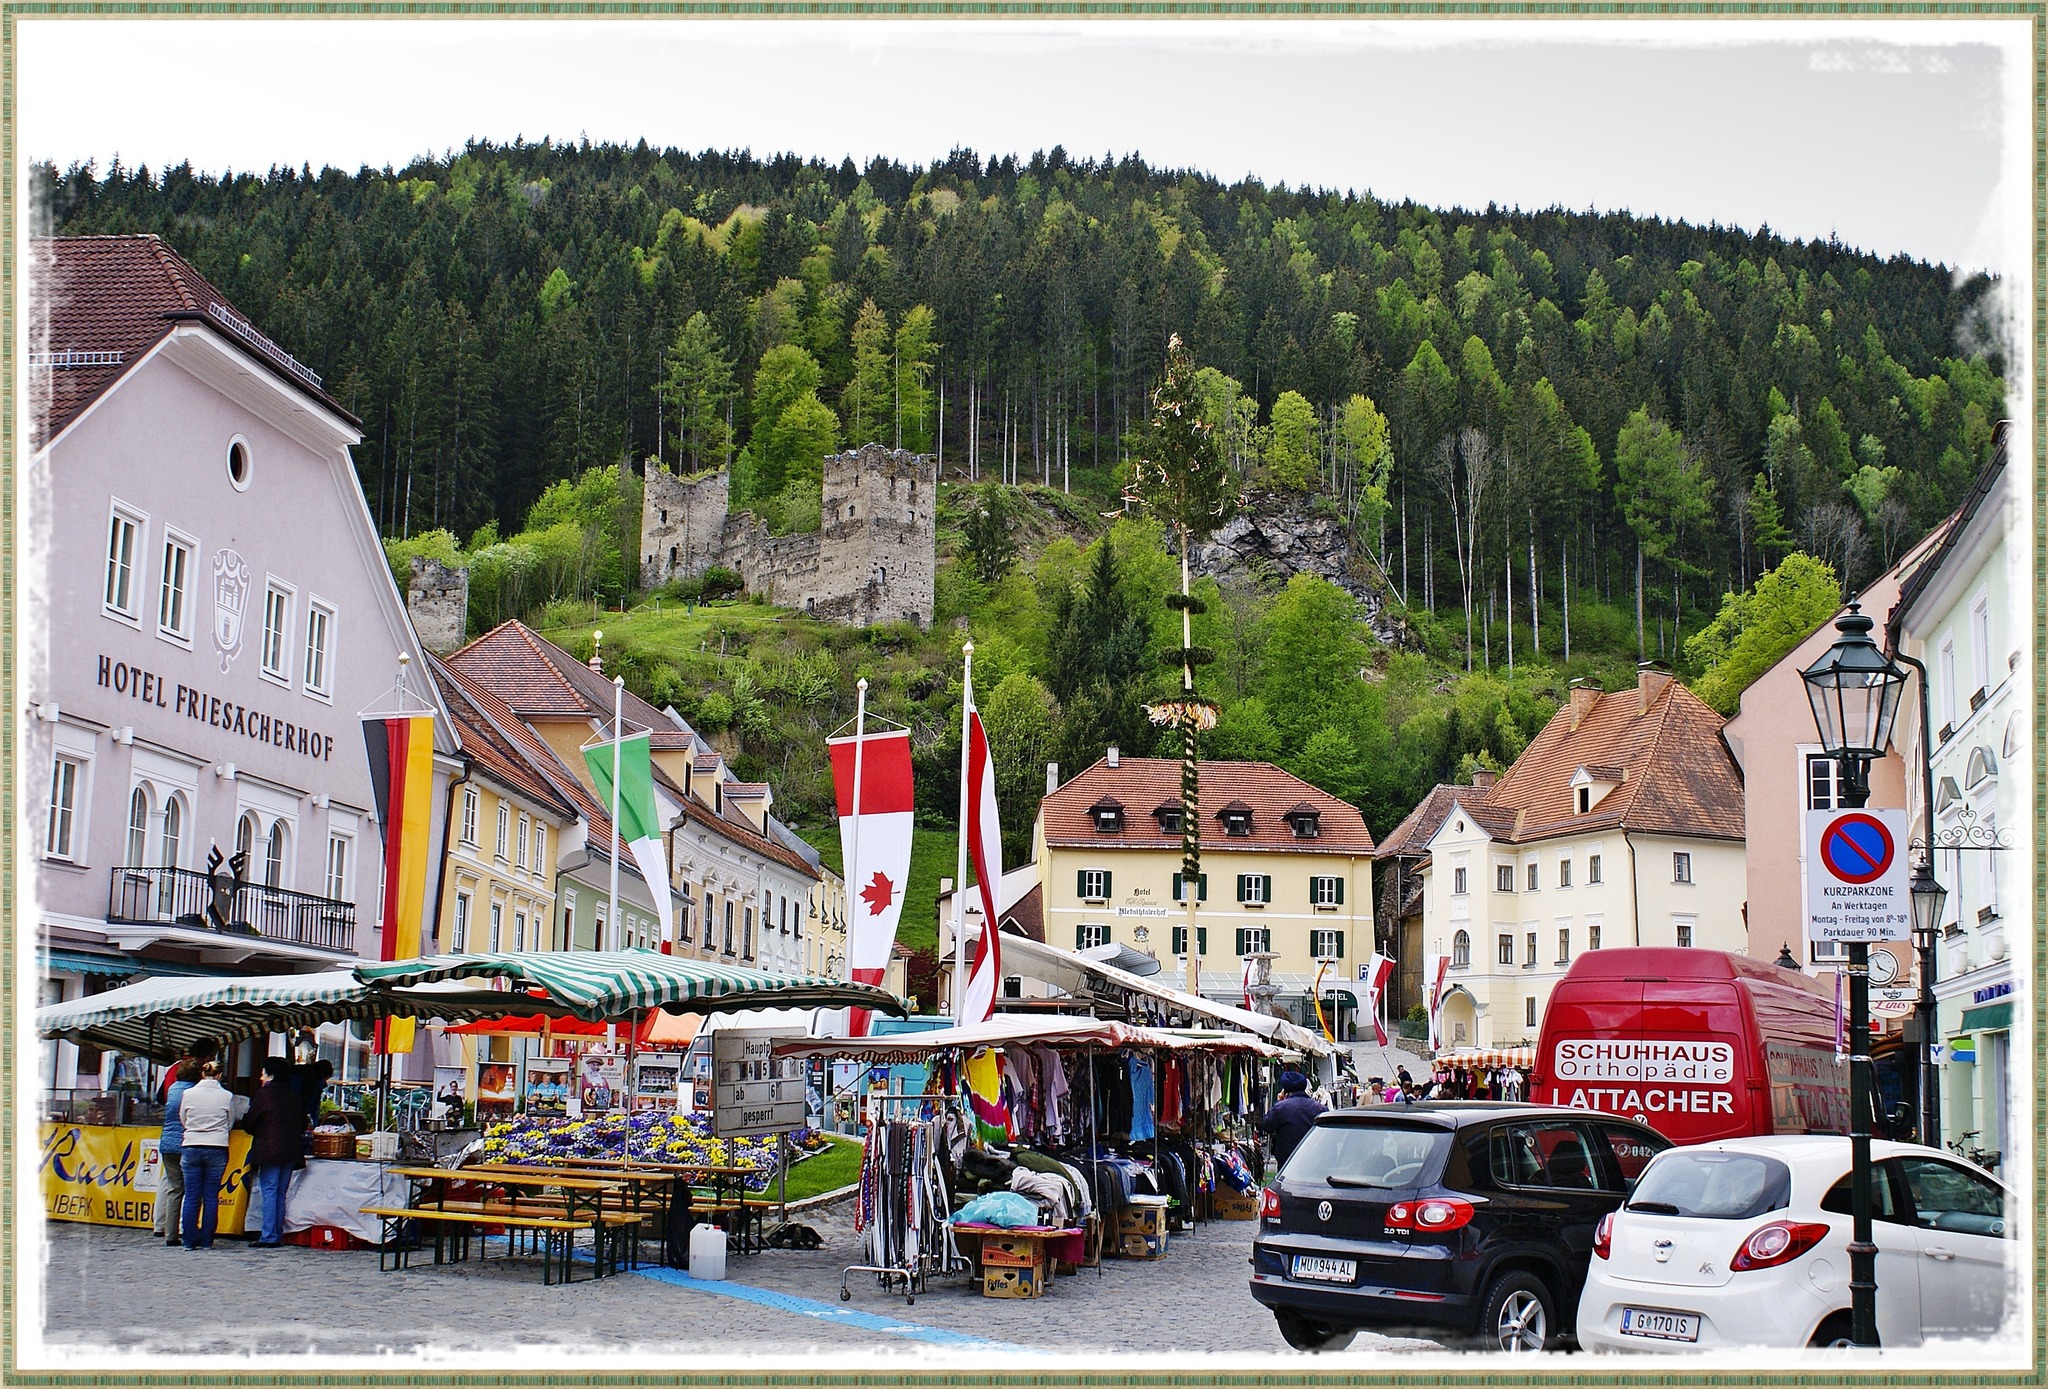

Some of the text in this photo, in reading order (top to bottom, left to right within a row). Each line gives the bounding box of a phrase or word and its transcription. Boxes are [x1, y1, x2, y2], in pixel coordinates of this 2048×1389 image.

[97, 655, 334, 762] HOTEL FRIESACHERHOF
[1823, 886, 1894, 896] KURZPARKZONE
[1831, 901, 1888, 911] An Werktagen
[1811, 915, 1837, 925] Montag
[1845, 915, 1870, 925] Freitag
[1871, 916, 1884, 924] von
[1823, 927, 1896, 937] Parkdauer 90 Min.
[1325, 993, 1348, 1001] HOTEL
[745, 1041, 772, 1058] Hauptp
[1560, 1044, 1728, 1063] SCHUHHAUS
[1560, 1061, 1728, 1080] Orthopädie
[735, 1086, 745, 1101] ab
[1552, 1088, 1735, 1114] LATTACHER
[743, 1107, 774, 1126] gesperrt
[1396, 1228, 1410, 1236] TDI
[1300, 1257, 1313, 1272] MU
[1318, 1259, 1337, 1274] 944
[1339, 1261, 1352, 1276] AL
[1637, 1314, 1646, 1328] G
[1653, 1316, 1673, 1332] 170
[1674, 1318, 1688, 1334] IS
